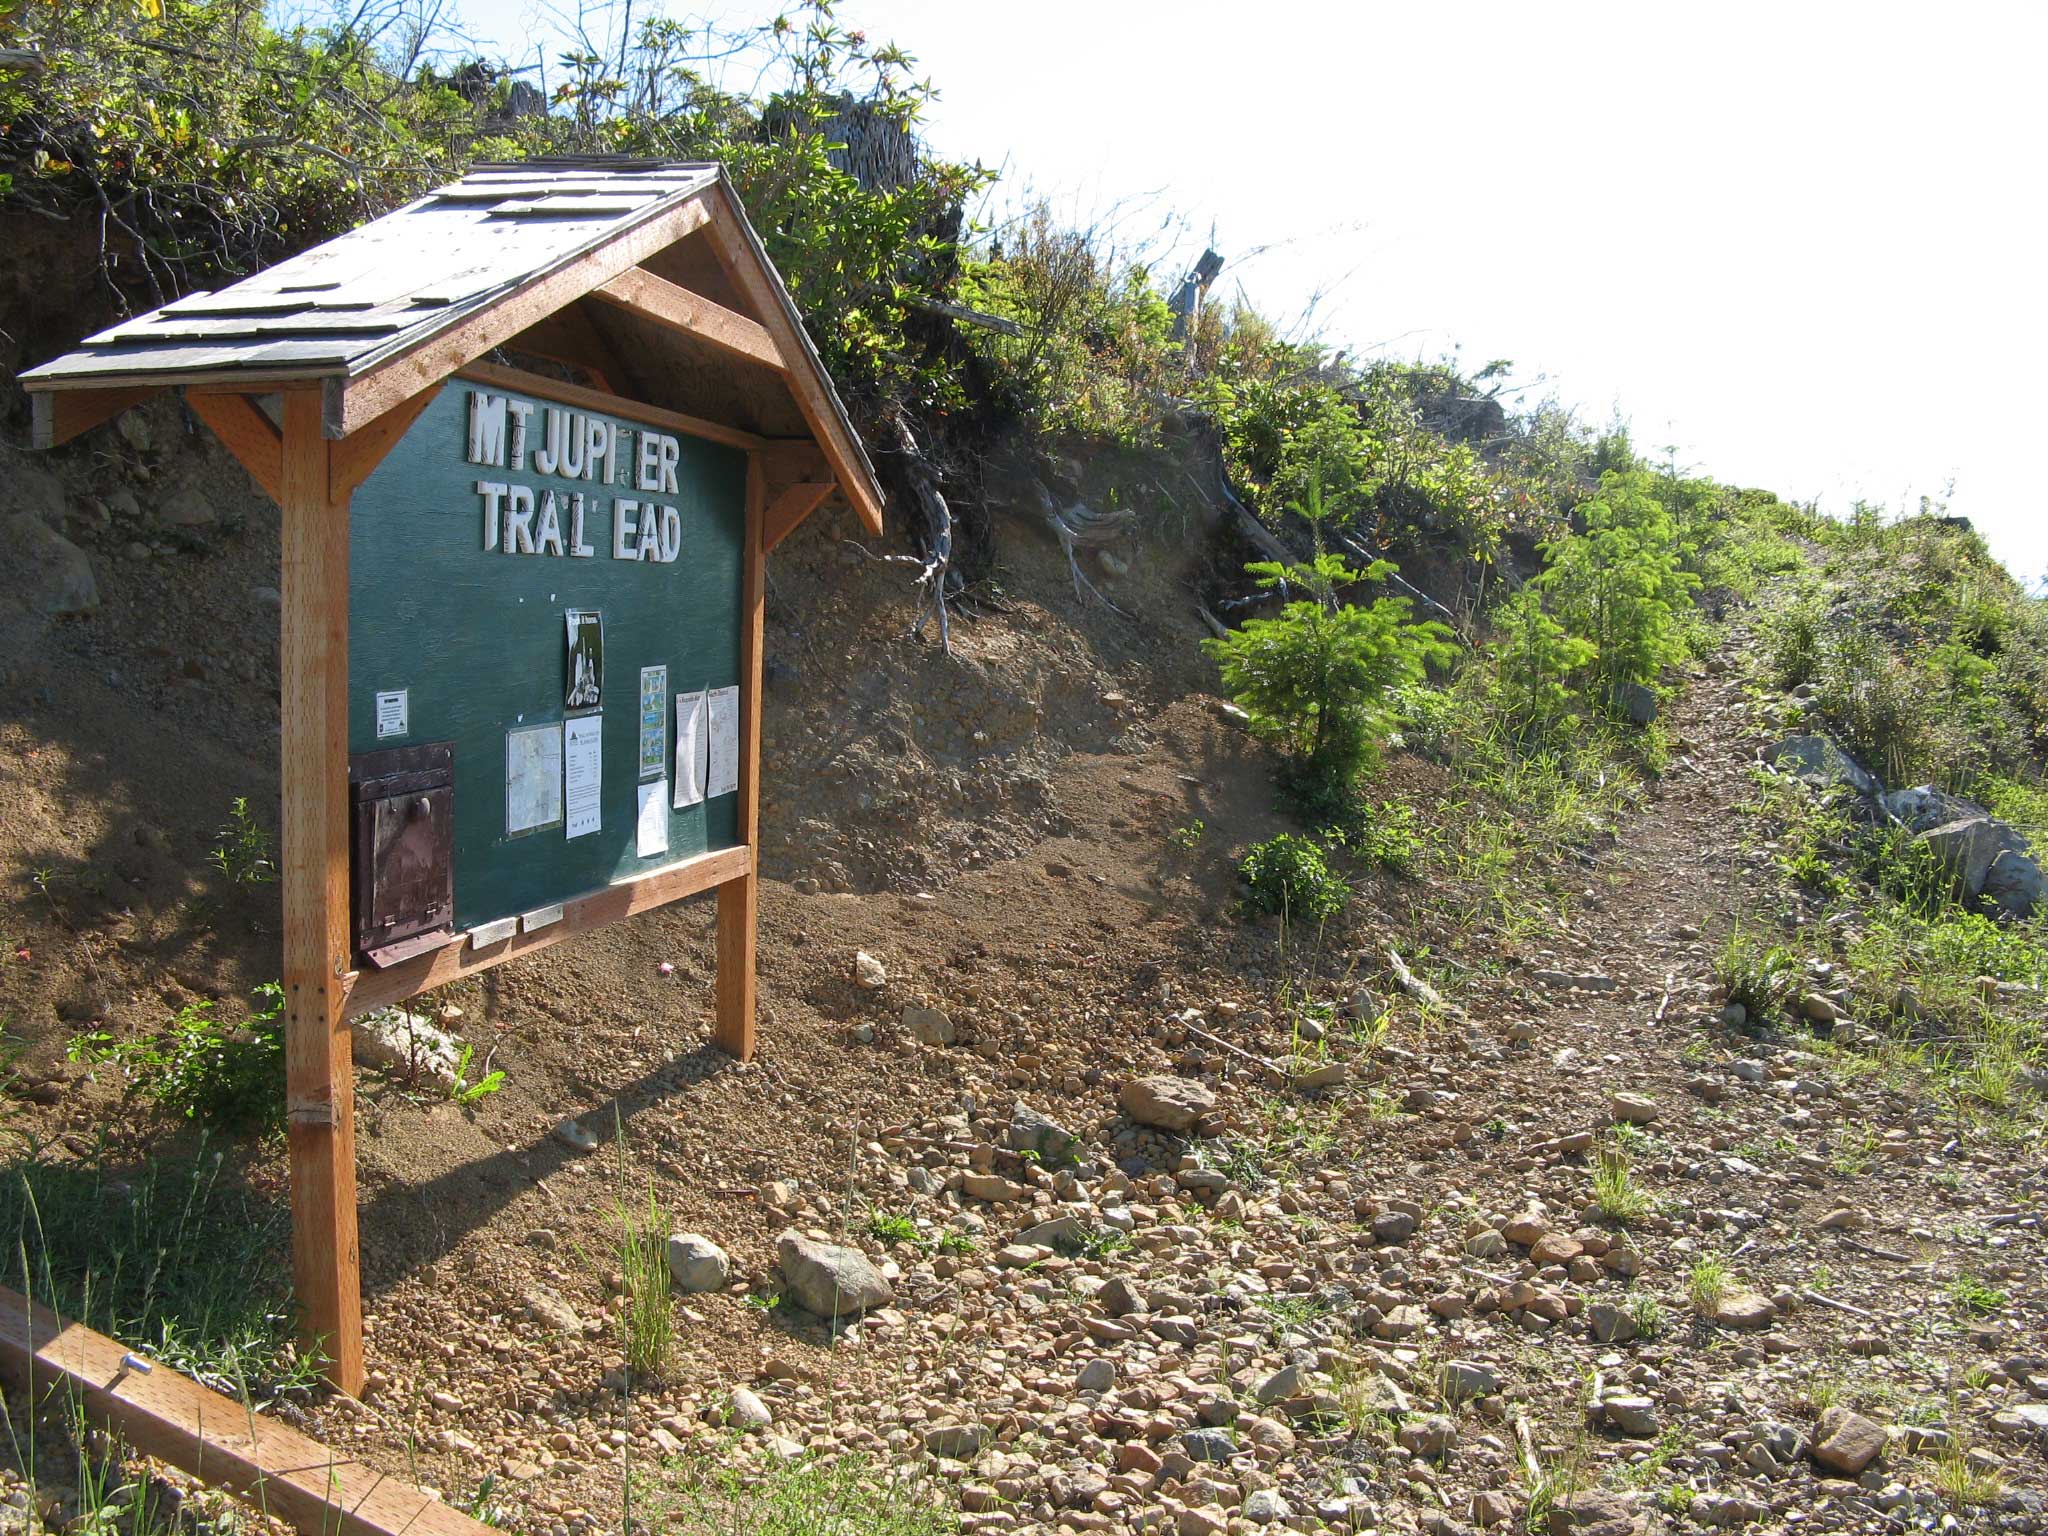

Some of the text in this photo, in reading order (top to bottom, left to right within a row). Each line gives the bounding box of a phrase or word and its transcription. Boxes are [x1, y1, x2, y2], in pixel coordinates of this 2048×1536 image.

[468, 391, 680, 494] MT JUPIER
[476, 480, 594, 557] TRAL
